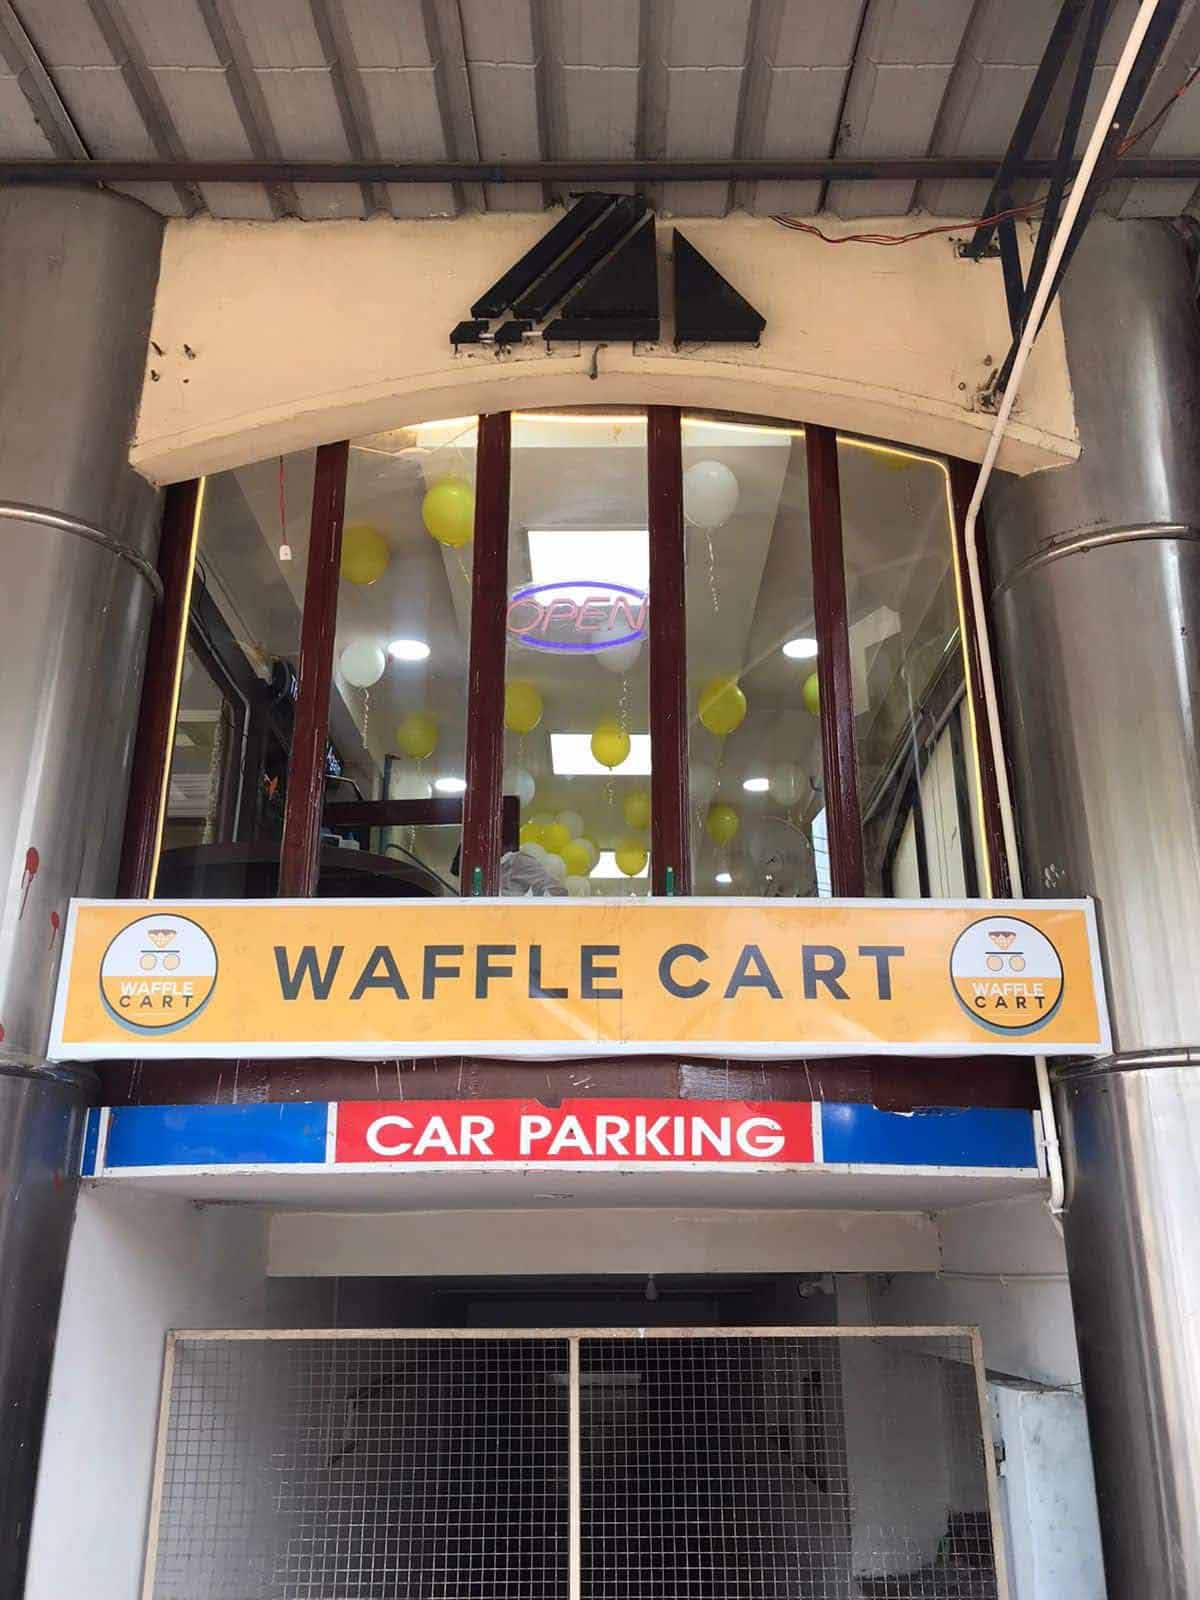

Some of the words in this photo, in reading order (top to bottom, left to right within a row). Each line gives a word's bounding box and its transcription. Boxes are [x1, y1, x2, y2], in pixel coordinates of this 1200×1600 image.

[507, 596, 649, 633] OPEN
[274, 944, 622, 1001] WAFFLE
[658, 943, 905, 1001] CART
[120, 981, 193, 996] WAFFLE
[971, 982, 1044, 997] WAFFLE
[119, 995, 194, 1008] CART
[974, 996, 1046, 1009] CART
[366, 1114, 494, 1156] CAR
[519, 1115, 786, 1158] PARKING
